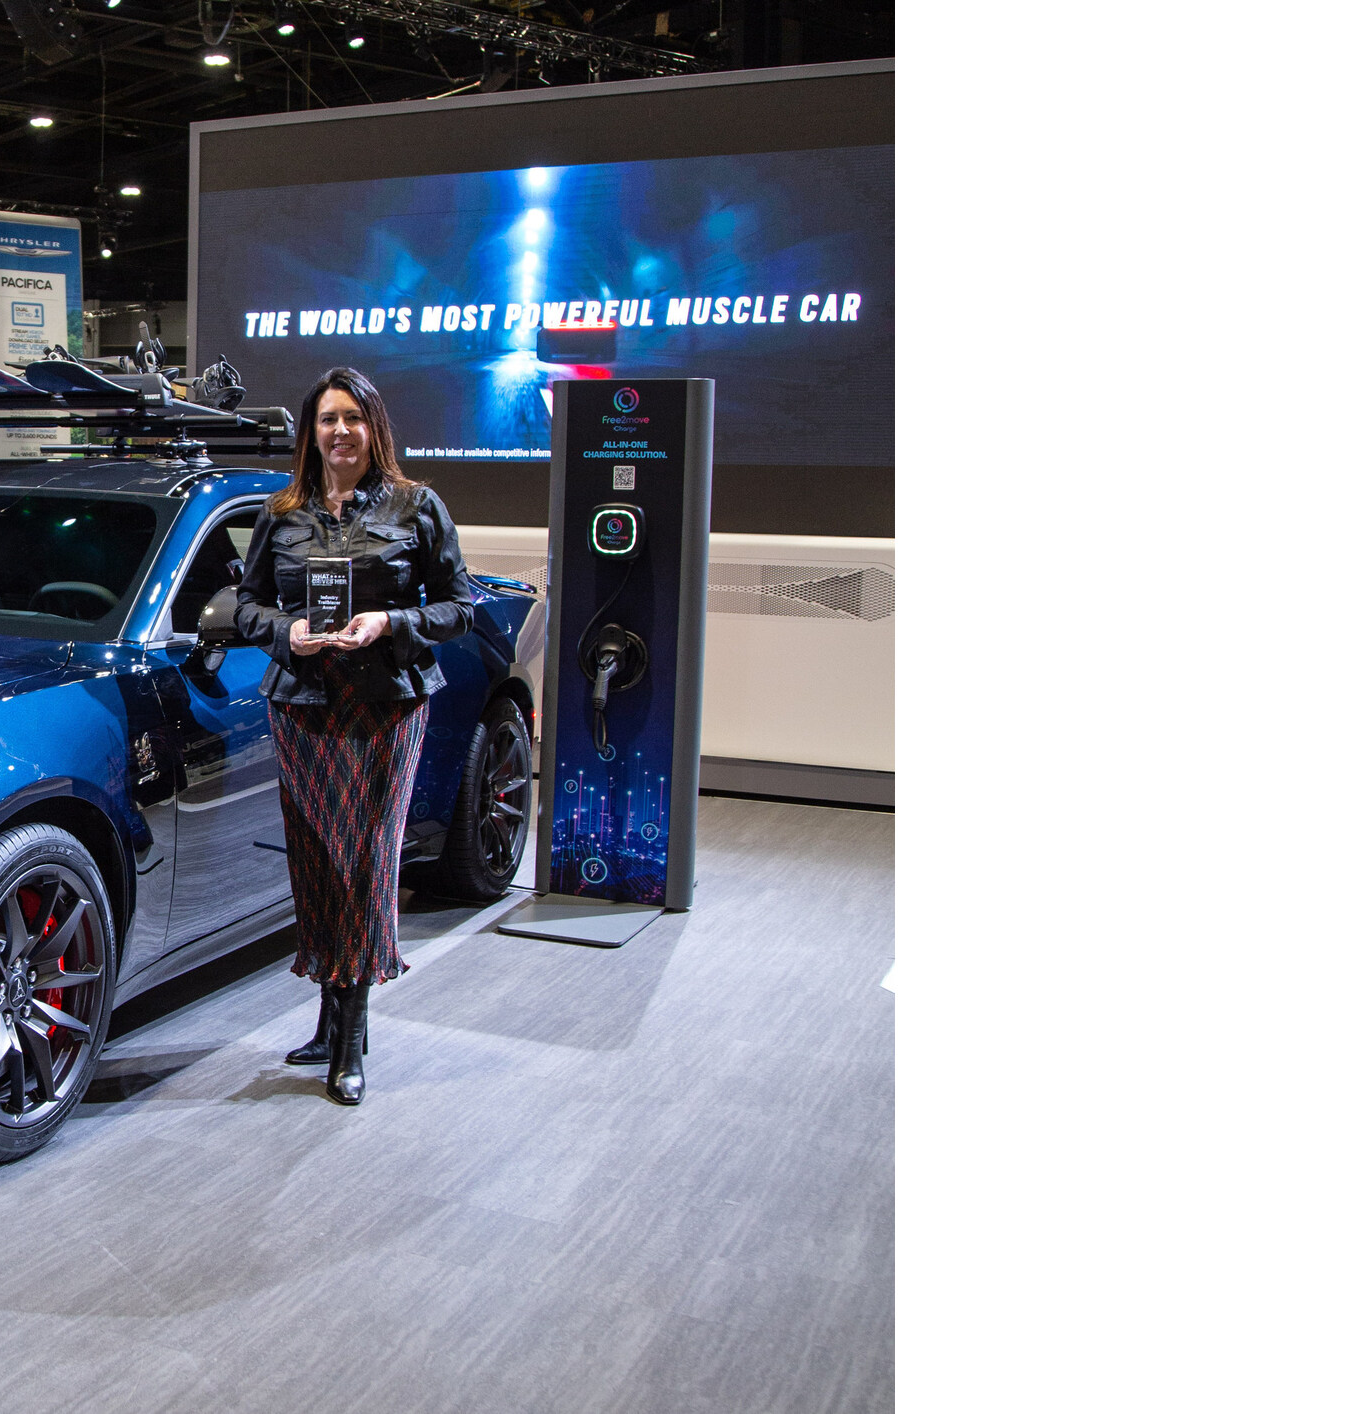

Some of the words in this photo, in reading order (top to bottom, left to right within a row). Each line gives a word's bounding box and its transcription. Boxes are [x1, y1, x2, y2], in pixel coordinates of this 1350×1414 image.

[1, 277, 53, 290] PACIFICA
[245, 311, 291, 338] THE
[299, 307, 412, 336] WORLD'S
[420, 304, 496, 333] MOST
[504, 299, 654, 330] POWERFUL
[665, 295, 790, 326] MUSCLE
[799, 293, 862, 323] CAR
[602, 415, 650, 424] Free2move
[405, 447, 425, 457] Based
[426, 449, 434, 457] on
[435, 448, 444, 457] the
[446, 448, 463, 457] latest
[464, 448, 493, 457] available
[493, 448, 530, 459] competitive
[625, 451, 668, 459] SOLUTION.
[32, 845, 74, 856] SPORT
